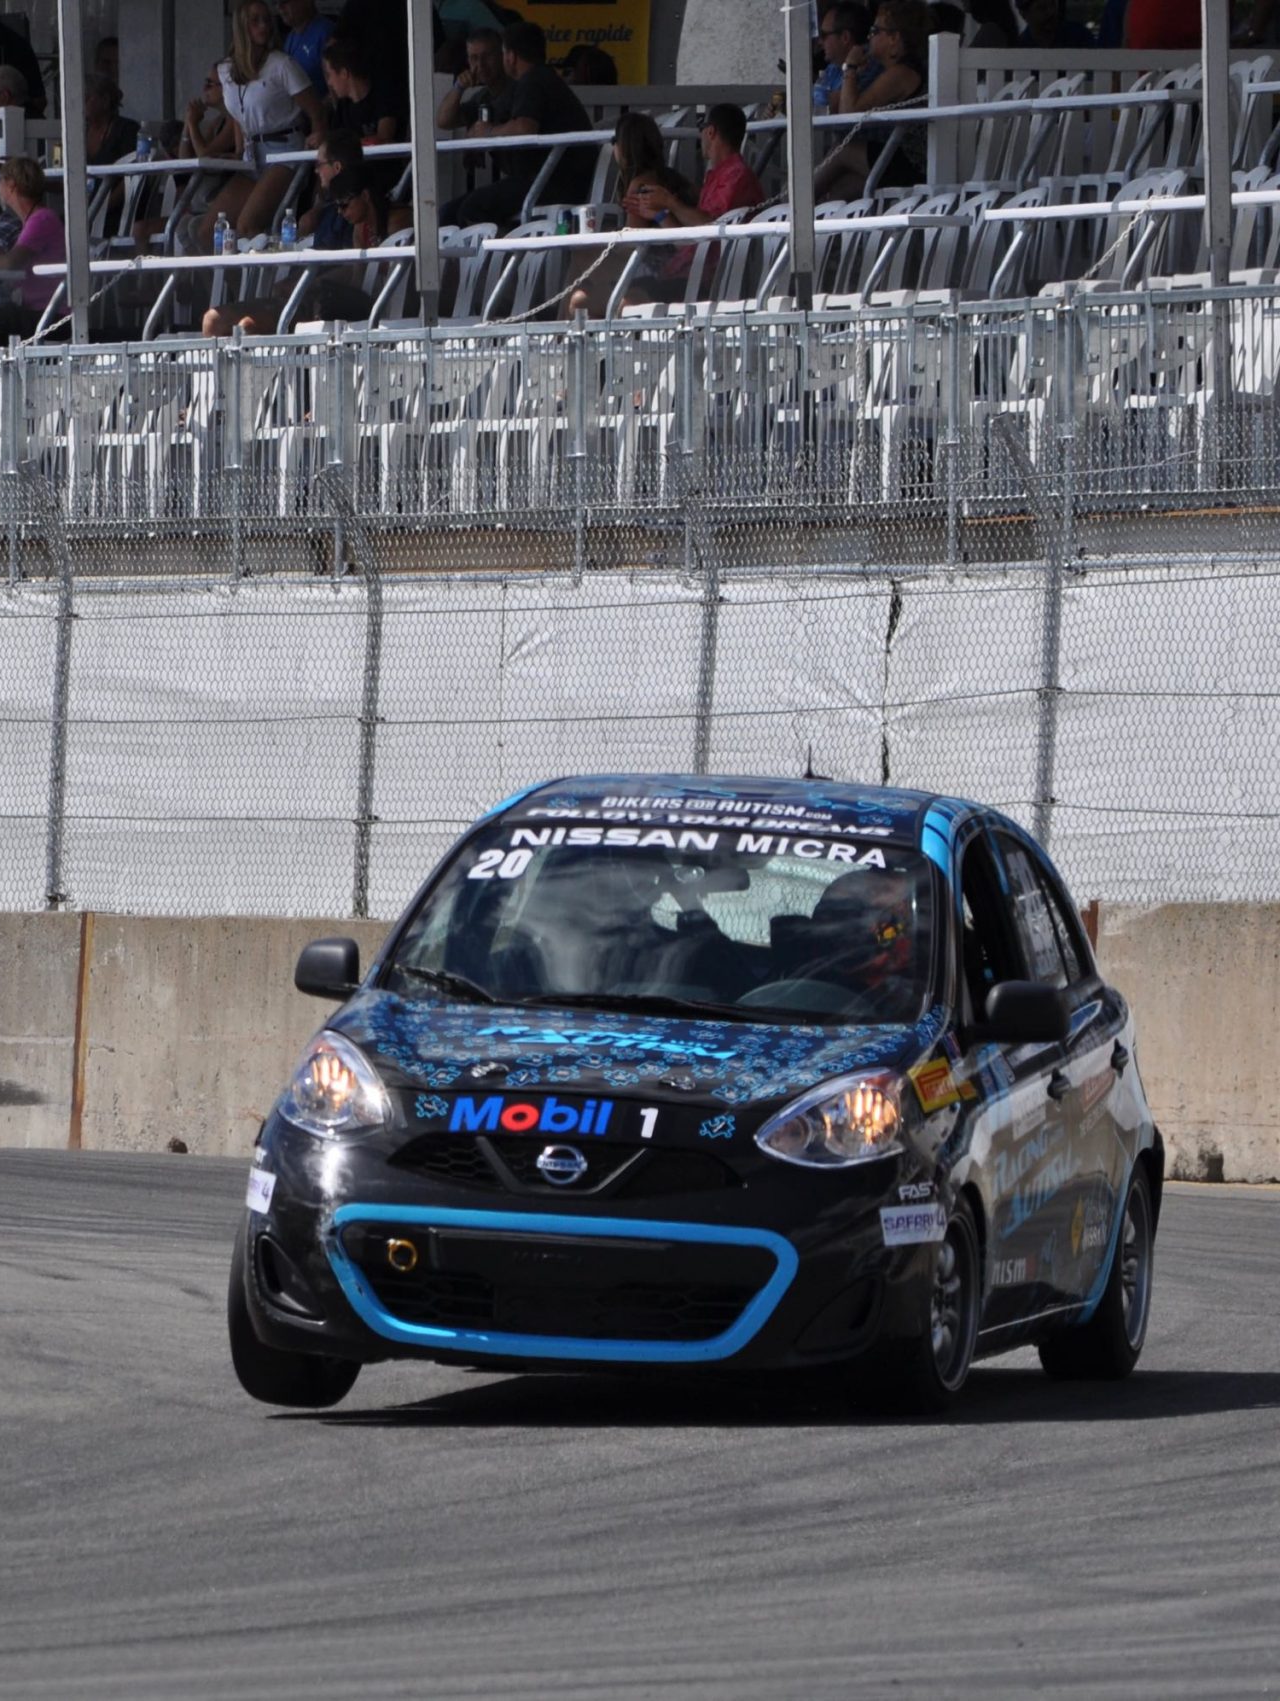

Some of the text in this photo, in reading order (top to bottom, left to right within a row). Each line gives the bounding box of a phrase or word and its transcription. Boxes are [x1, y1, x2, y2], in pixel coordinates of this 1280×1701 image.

[576, 24, 634, 46] rapide
[601, 797, 684, 810] BIKERS
[526, 807, 652, 822] FOLLOW
[666, 813, 751, 828] YOUR
[510, 827, 888, 870] NISSAN MICRA
[467, 848, 534, 880] 20
[449, 1096, 660, 1139] Mobil 1
